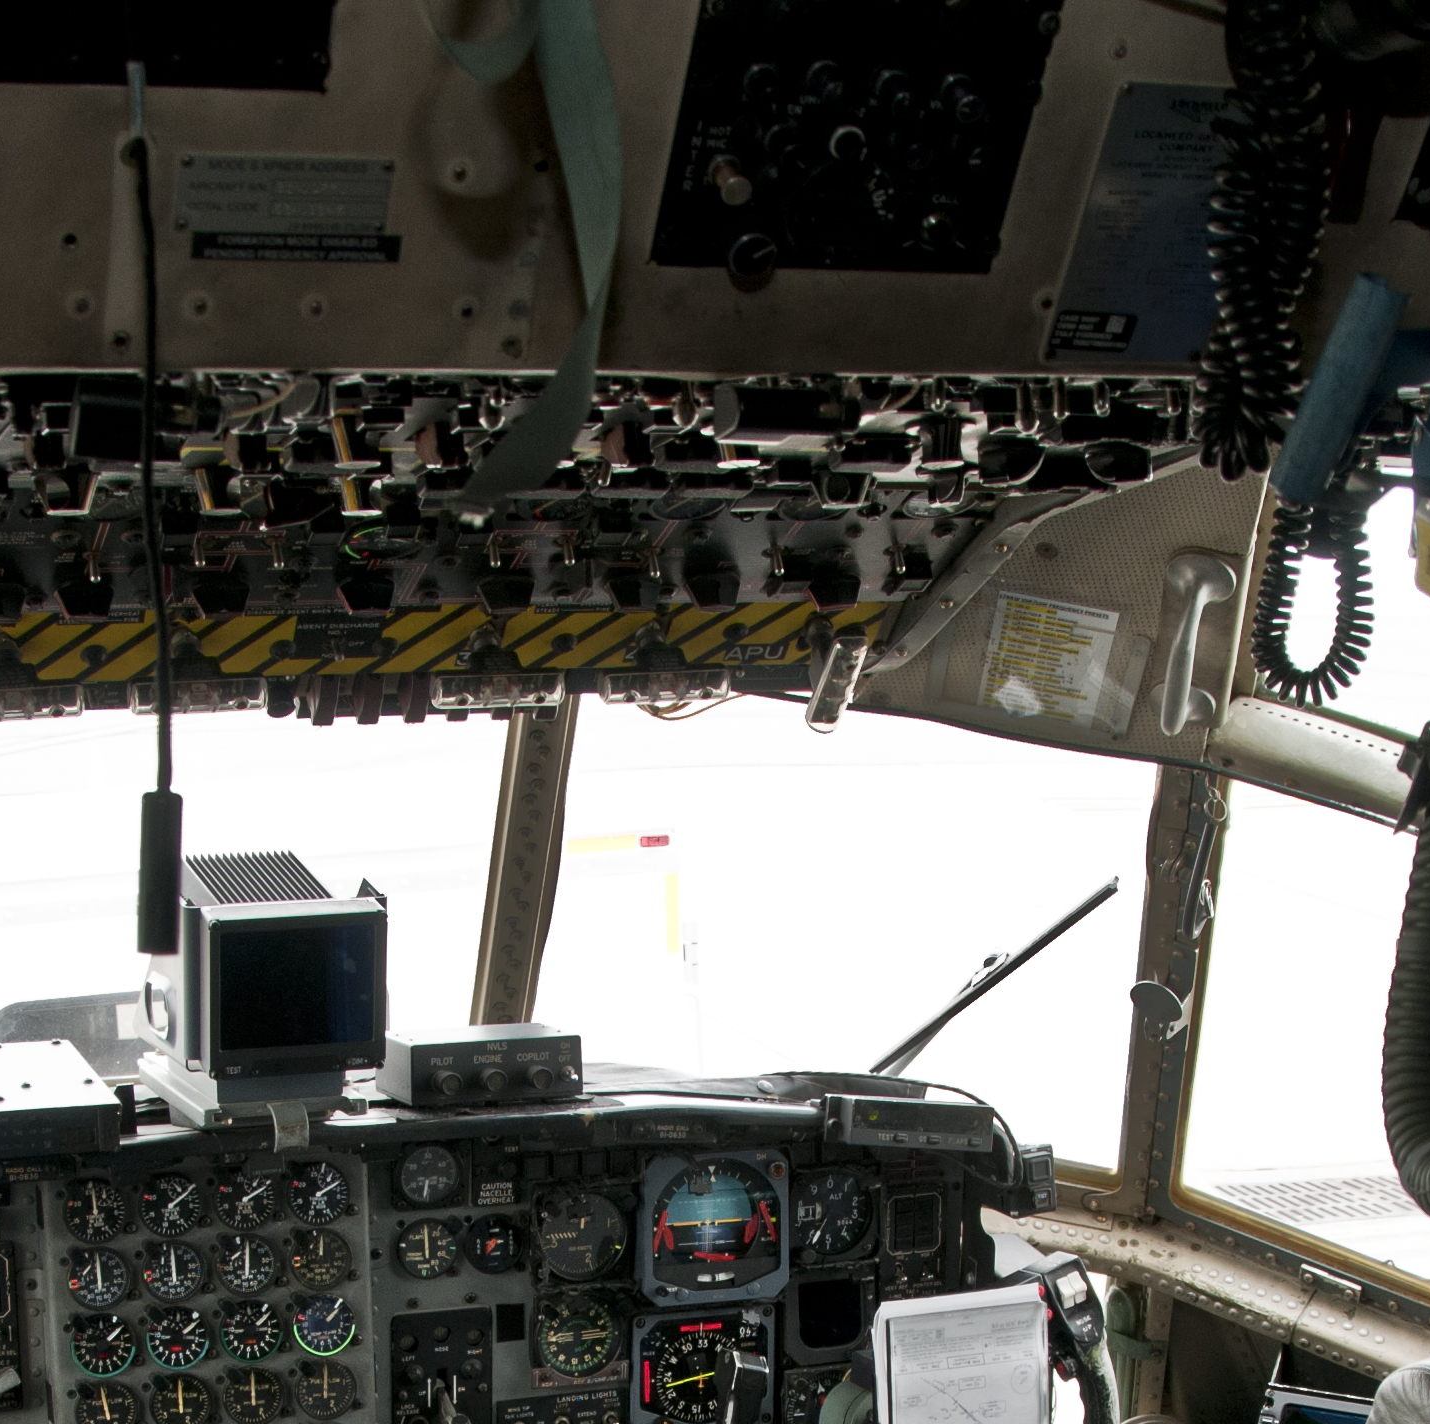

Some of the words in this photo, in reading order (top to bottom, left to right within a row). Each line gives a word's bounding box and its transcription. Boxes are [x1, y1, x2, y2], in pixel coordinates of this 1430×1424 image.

[932, 193, 959, 204] CALL
[287, 236, 319, 247] MODE
[724, 646, 784, 661] APU
[487, 1041, 508, 1051] NVLS
[430, 1056, 454, 1067] PILOT
[473, 1054, 503, 1065] ENGINE
[516, 1051, 550, 1063] COPILOT
[225, 1065, 242, 1076] TEST
[481, 1182, 513, 1190] CAUTION
[480, 1189, 513, 1197] NACELLE
[829, 1192, 843, 1201] ALT
[477, 1196, 515, 1205] OVERHEAT
[852, 1196, 859, 1207] 2
[851, 1209, 859, 1219] 3
[697, 1339, 708, 1349] 33
[714, 1343, 723, 1353] N
[556, 1393, 589, 1404] LANDING
[591, 1389, 618, 1400] LIGHTS
